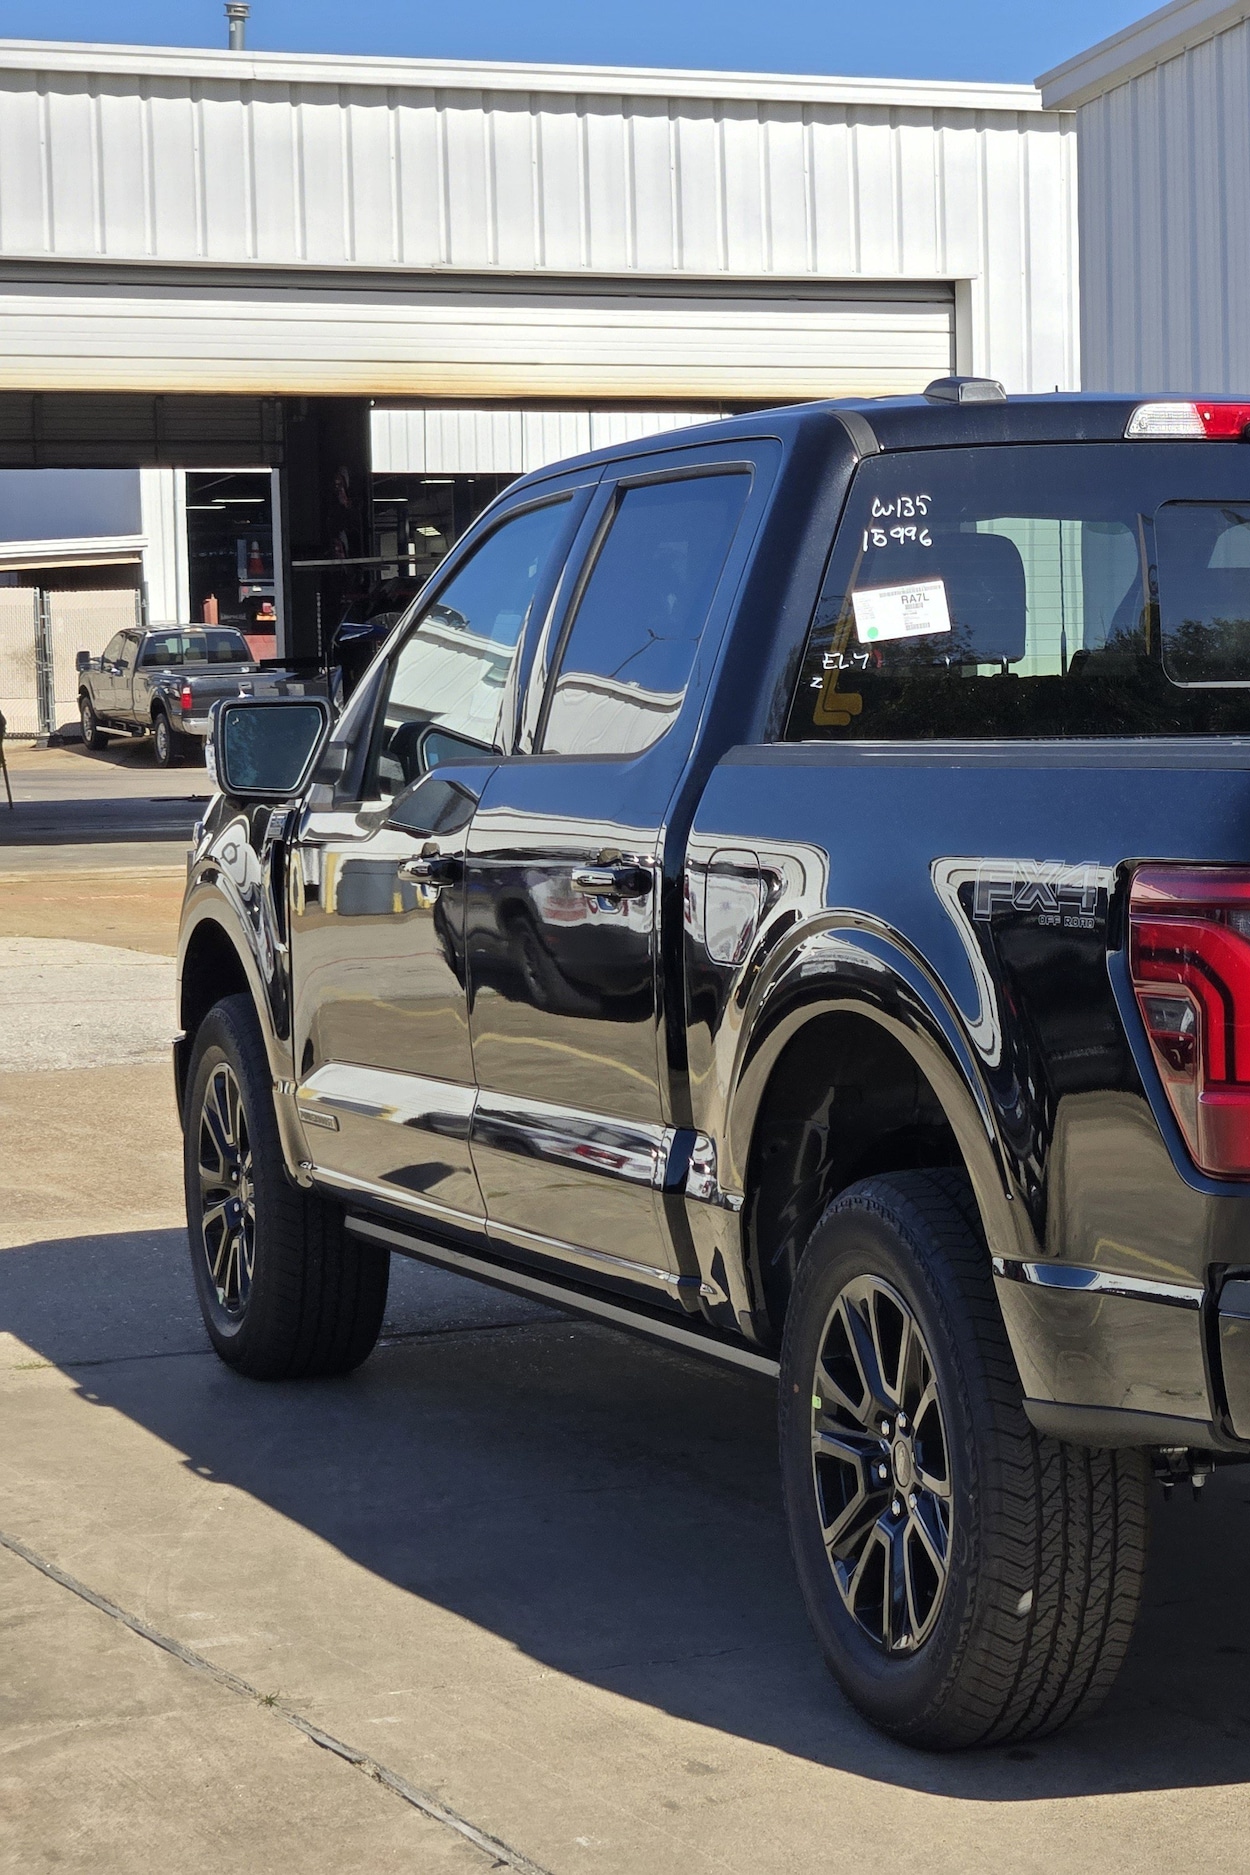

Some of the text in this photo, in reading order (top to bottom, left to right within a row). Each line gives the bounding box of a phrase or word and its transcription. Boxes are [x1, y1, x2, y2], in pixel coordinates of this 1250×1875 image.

[863, 526, 933, 551] 15996
[901, 593, 930, 604] RA7L
[973, 857, 1100, 921] FX4
[1038, 914, 1095, 928] OFF ROAD
